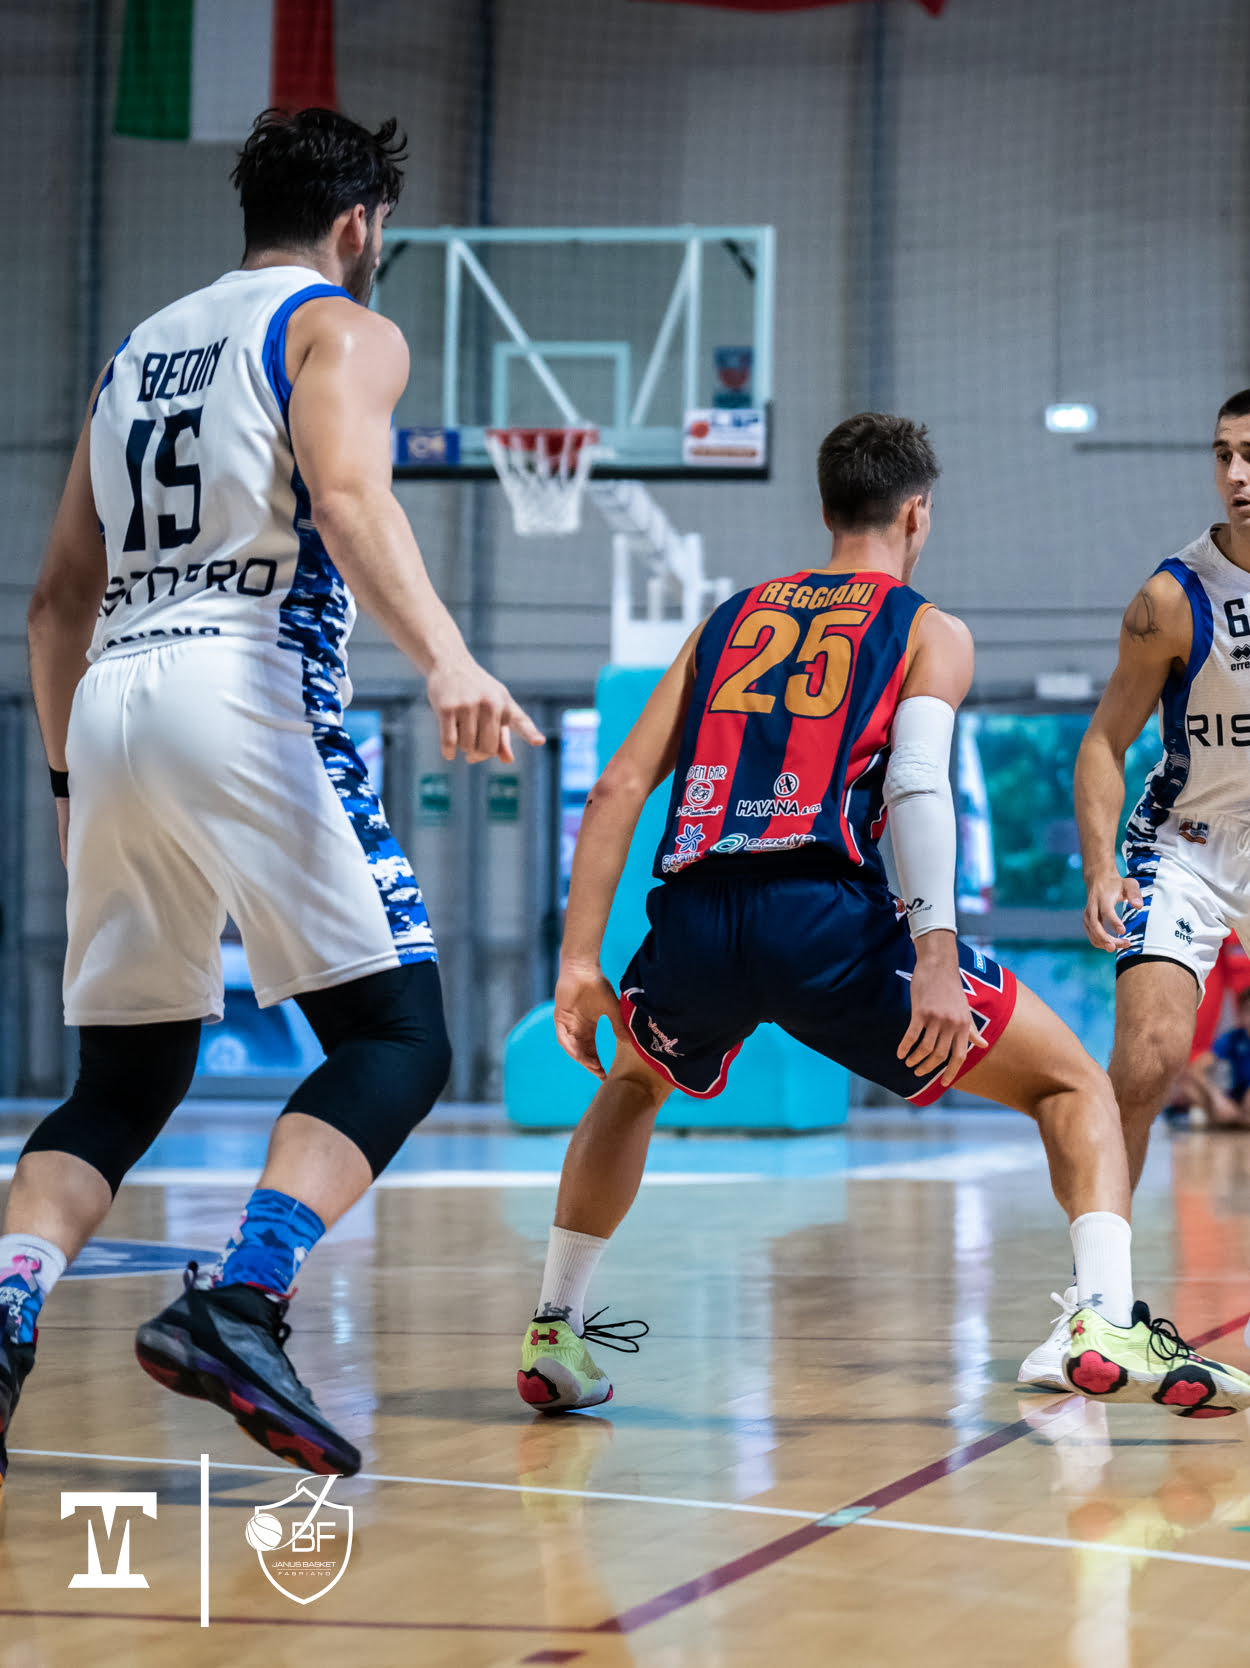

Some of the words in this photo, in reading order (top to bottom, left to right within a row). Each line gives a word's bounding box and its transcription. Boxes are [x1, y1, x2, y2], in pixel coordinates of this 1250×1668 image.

[137, 337, 228, 402] BEDIN
[122, 404, 203, 553] 15
[100, 557, 277, 616] STOPRO
[757, 581, 878, 610] REGGIANI
[1224, 598, 1250, 638] 6
[707, 609, 871, 719] 25
[708, 765, 727, 780] BAR
[736, 800, 799, 817] HAVANA
[1174, 930, 1193, 945] erre
